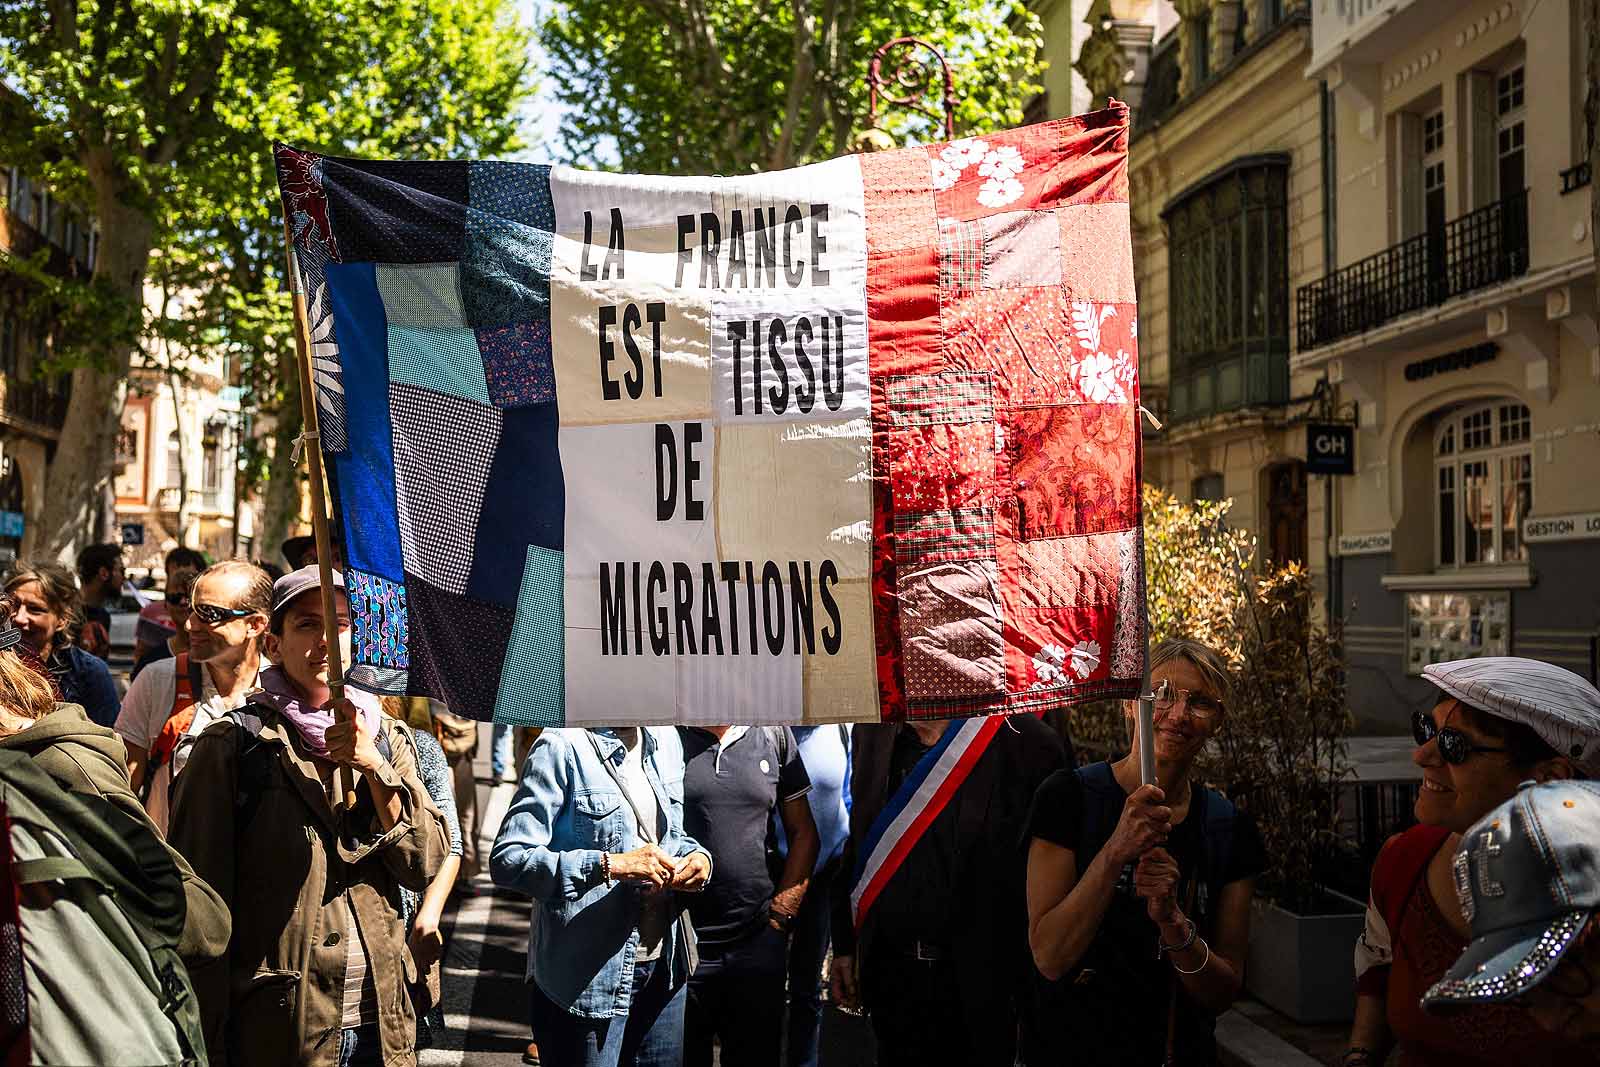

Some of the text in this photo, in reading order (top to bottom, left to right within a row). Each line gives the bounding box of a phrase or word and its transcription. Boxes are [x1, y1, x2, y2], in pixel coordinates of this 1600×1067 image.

[580, 203, 830, 289] LA FRANCE
[599, 302, 844, 416] EST TISSU
[655, 422, 704, 521] DE
[1315, 434, 1345, 454] GH
[1340, 536, 1390, 550] TRANSACTION
[1527, 519, 1575, 537] GESTION
[600, 559, 842, 656] MIGRATIONS
